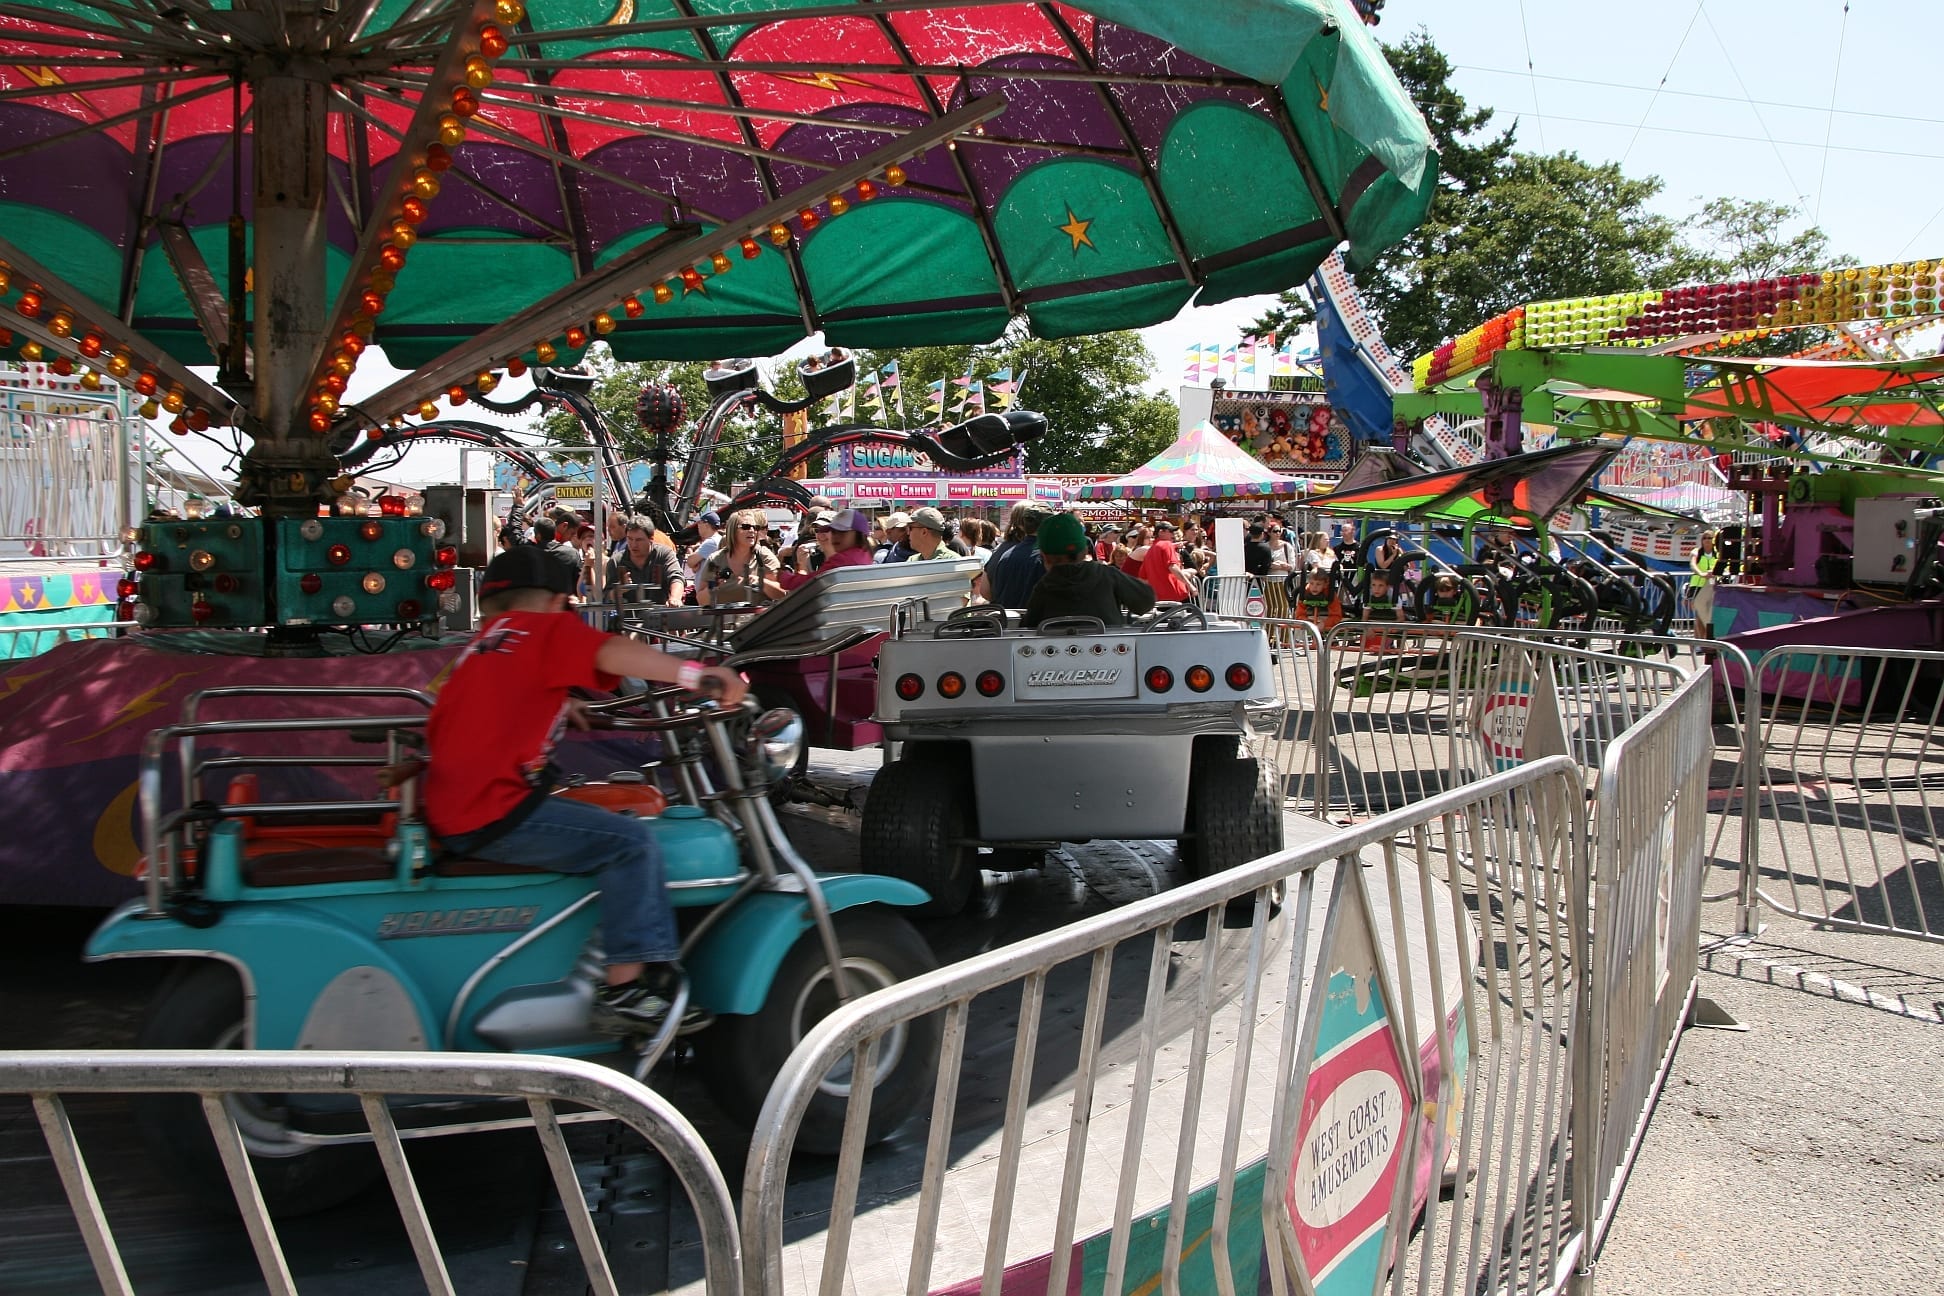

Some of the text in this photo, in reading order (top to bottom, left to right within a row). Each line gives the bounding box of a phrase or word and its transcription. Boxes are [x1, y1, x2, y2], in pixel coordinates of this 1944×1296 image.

[557, 487, 593, 498] ENTRANCE
[858, 484, 933, 496] COTTON CANDY
[950, 485, 1026, 497] CANDY APPLES CARAMEL
[1027, 668, 1121, 686] HAMPTON
[378, 905, 541, 937] HAMPTON
[1311, 1090, 1387, 1170] WEST COAST
[1311, 1125, 1389, 1211] AMUSEMENTS
